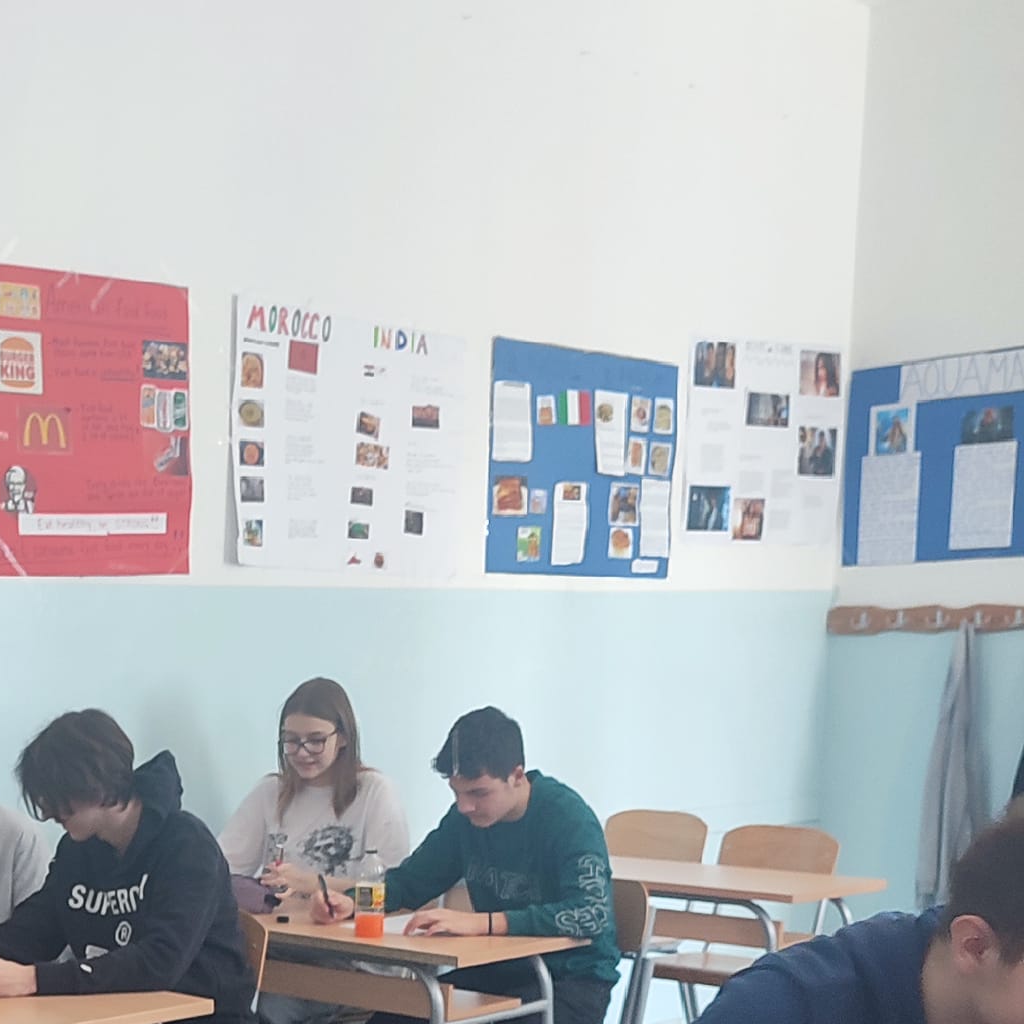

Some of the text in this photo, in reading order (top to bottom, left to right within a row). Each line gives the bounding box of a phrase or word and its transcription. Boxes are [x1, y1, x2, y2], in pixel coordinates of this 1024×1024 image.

[246, 304, 332, 343] MOROCCO
[373, 325, 428, 356] INDIA
[0, 364, 36, 381] KING
[68, 873, 149, 916] SUPERY
